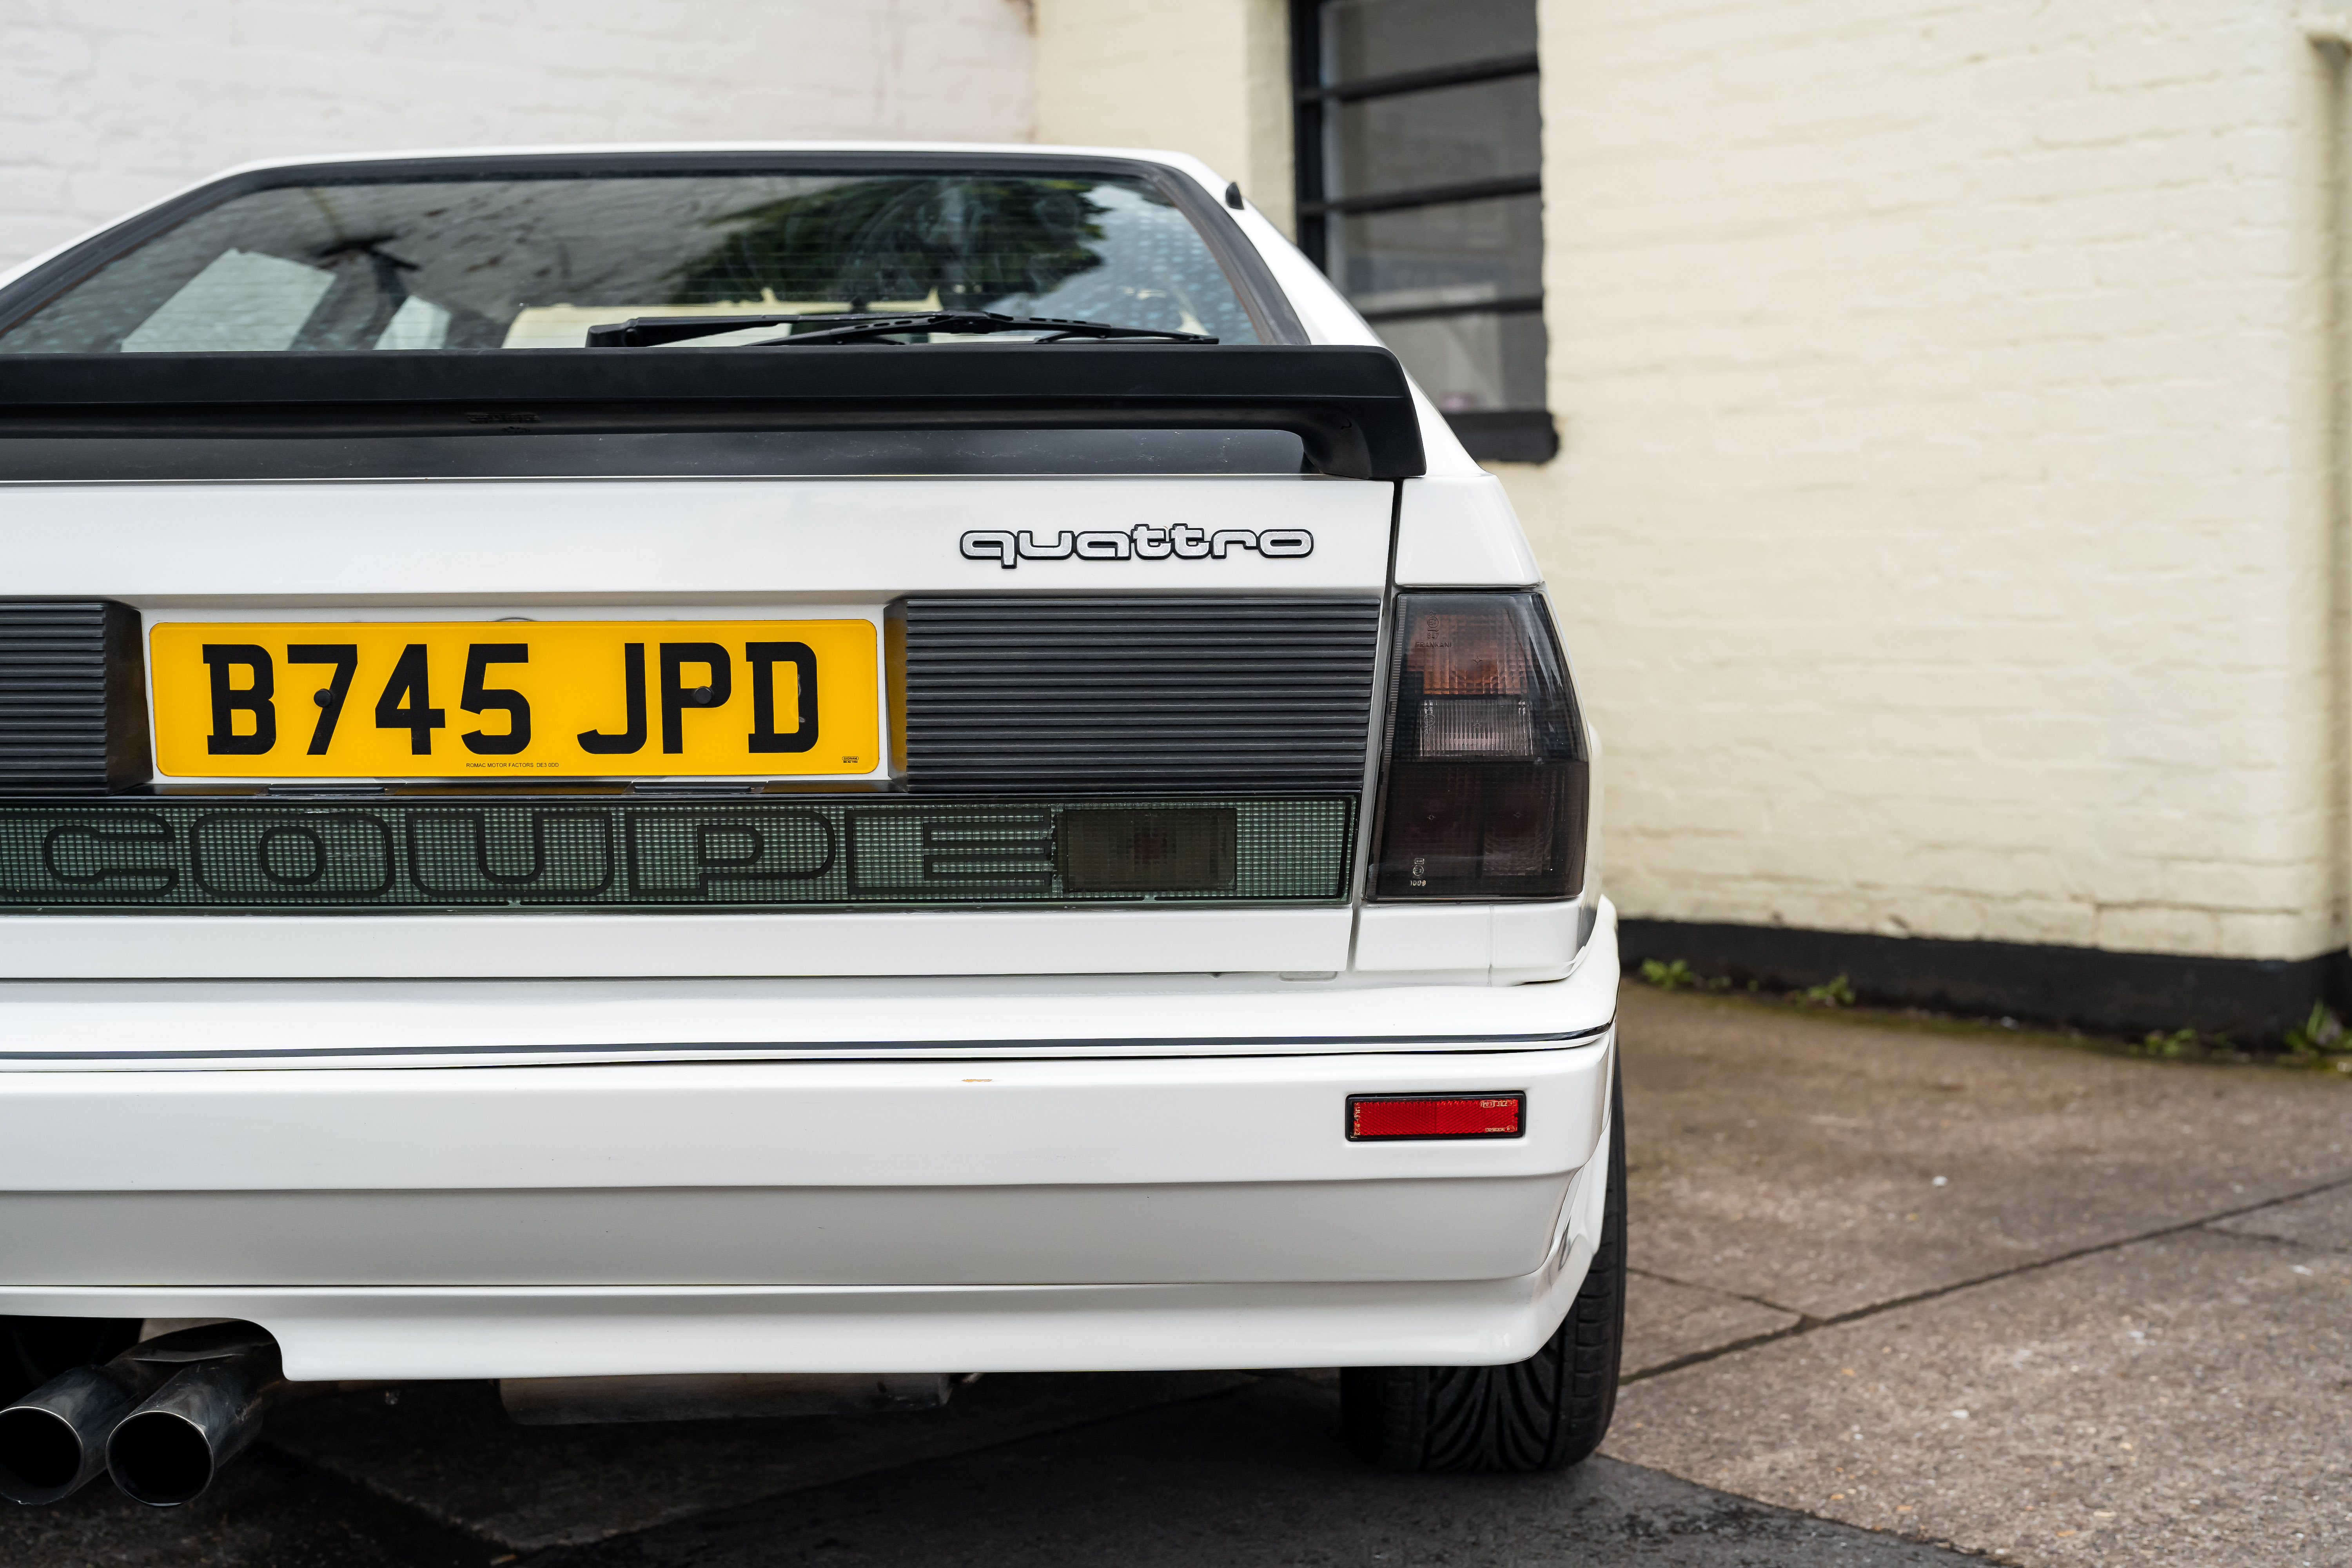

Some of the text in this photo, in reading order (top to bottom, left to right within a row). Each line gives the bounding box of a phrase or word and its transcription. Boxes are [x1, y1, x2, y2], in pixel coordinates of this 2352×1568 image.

[960, 523, 1314, 570] quattro
[202, 641, 818, 755] B745 JPD
[0, 808, 1051, 898] COUPE
